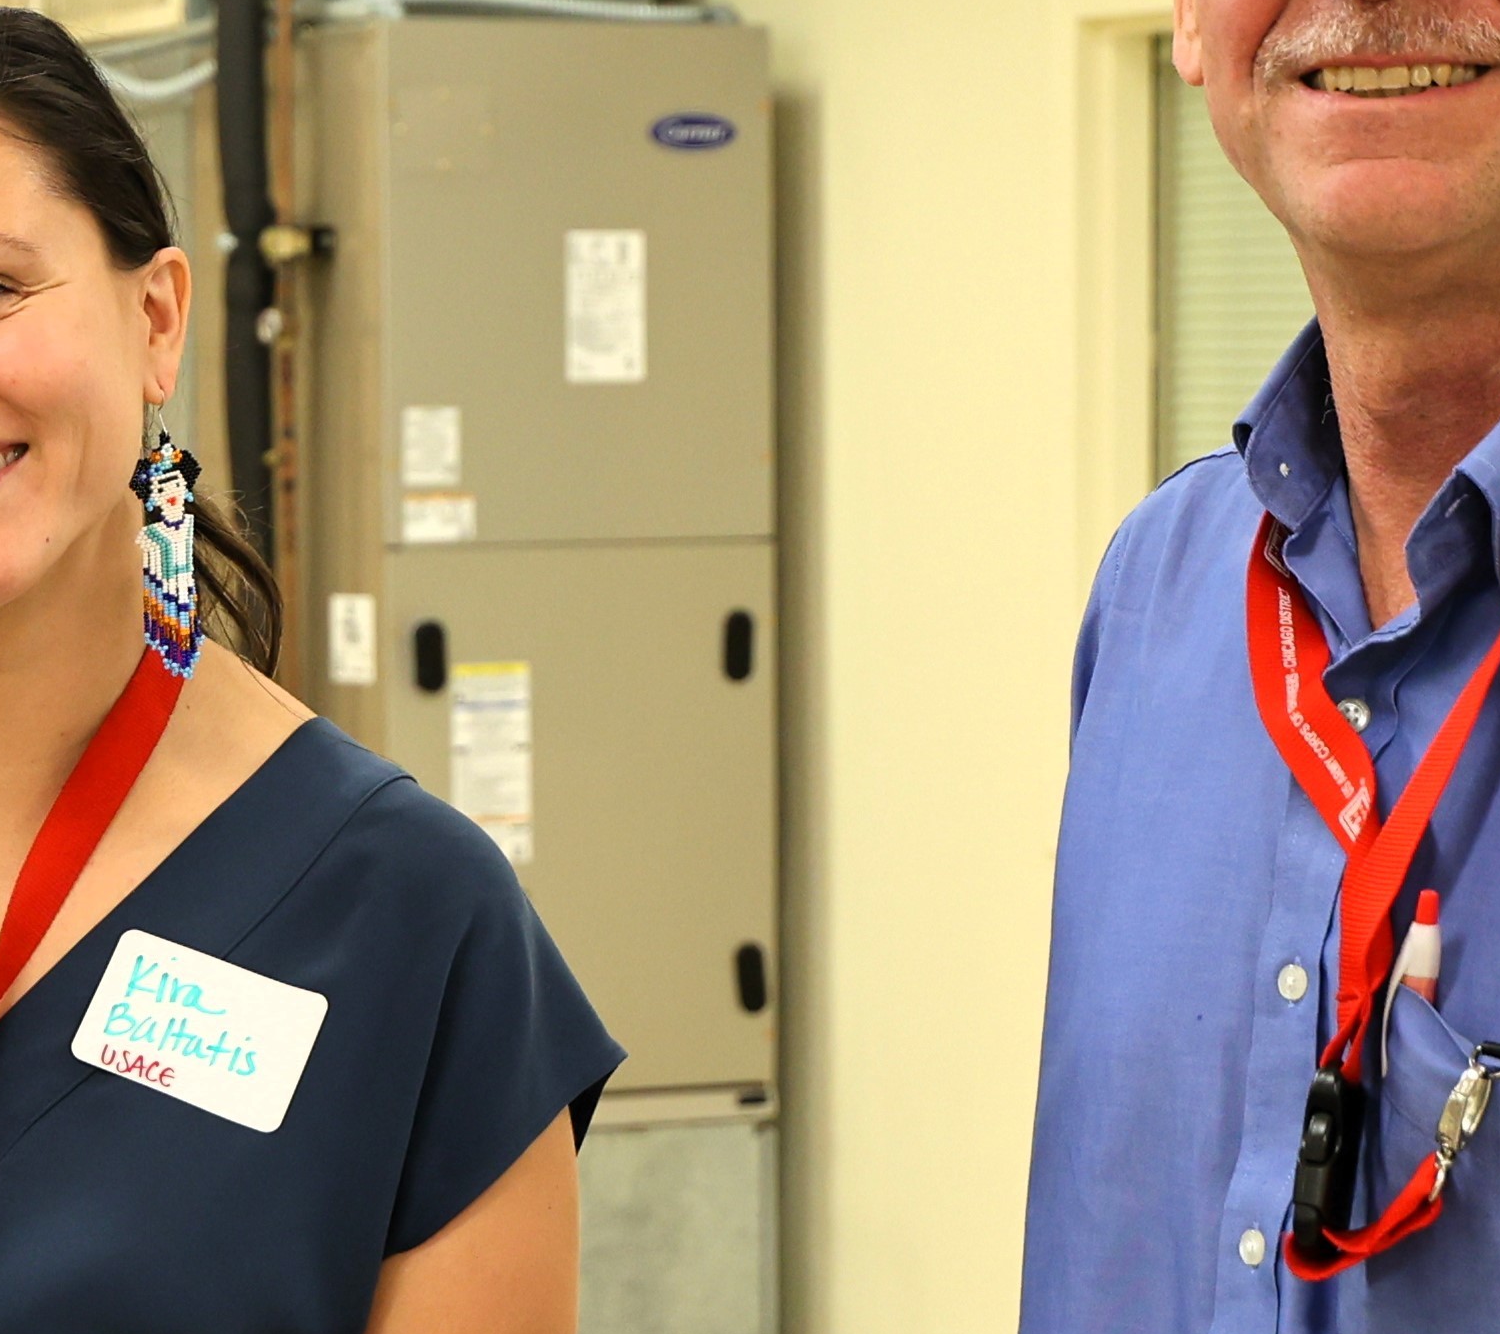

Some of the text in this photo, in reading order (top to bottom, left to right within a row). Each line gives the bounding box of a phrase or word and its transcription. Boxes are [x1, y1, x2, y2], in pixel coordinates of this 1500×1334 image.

[1278, 587, 1294, 625] DISTRICT
[1279, 625, 1297, 668] CHICAGO
[1299, 722, 1330, 760] CORPS
[123, 954, 227, 1015] Kira
[100, 1044, 176, 1088] USACE
